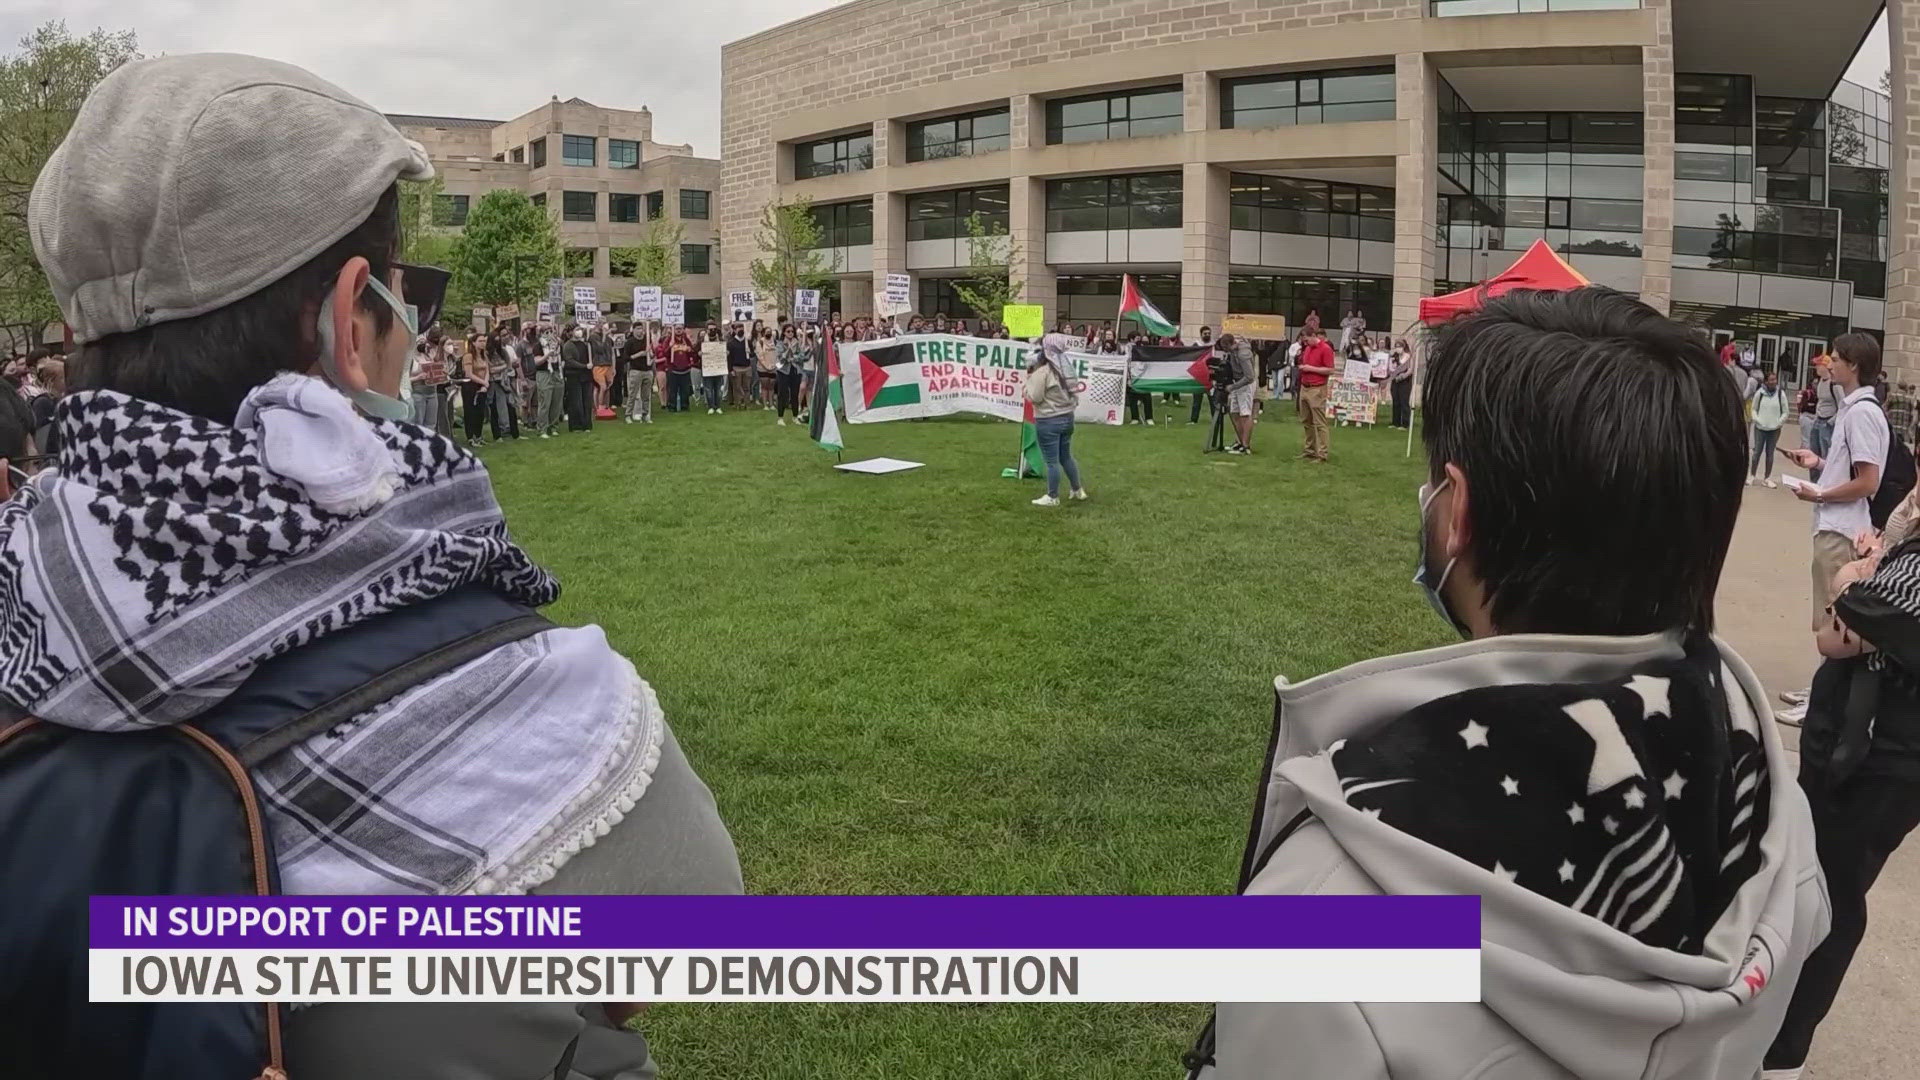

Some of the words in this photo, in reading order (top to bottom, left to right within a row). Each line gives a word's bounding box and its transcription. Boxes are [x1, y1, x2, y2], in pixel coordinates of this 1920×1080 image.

[732, 292, 752, 302] FREE
[577, 311, 596, 320] FREE!
[916, 341, 967, 363] FREE
[921, 363, 954, 378] END
[961, 366, 989, 380] ALL
[996, 369, 1023, 384] U.S.
[928, 377, 1015, 397] APARTHEID
